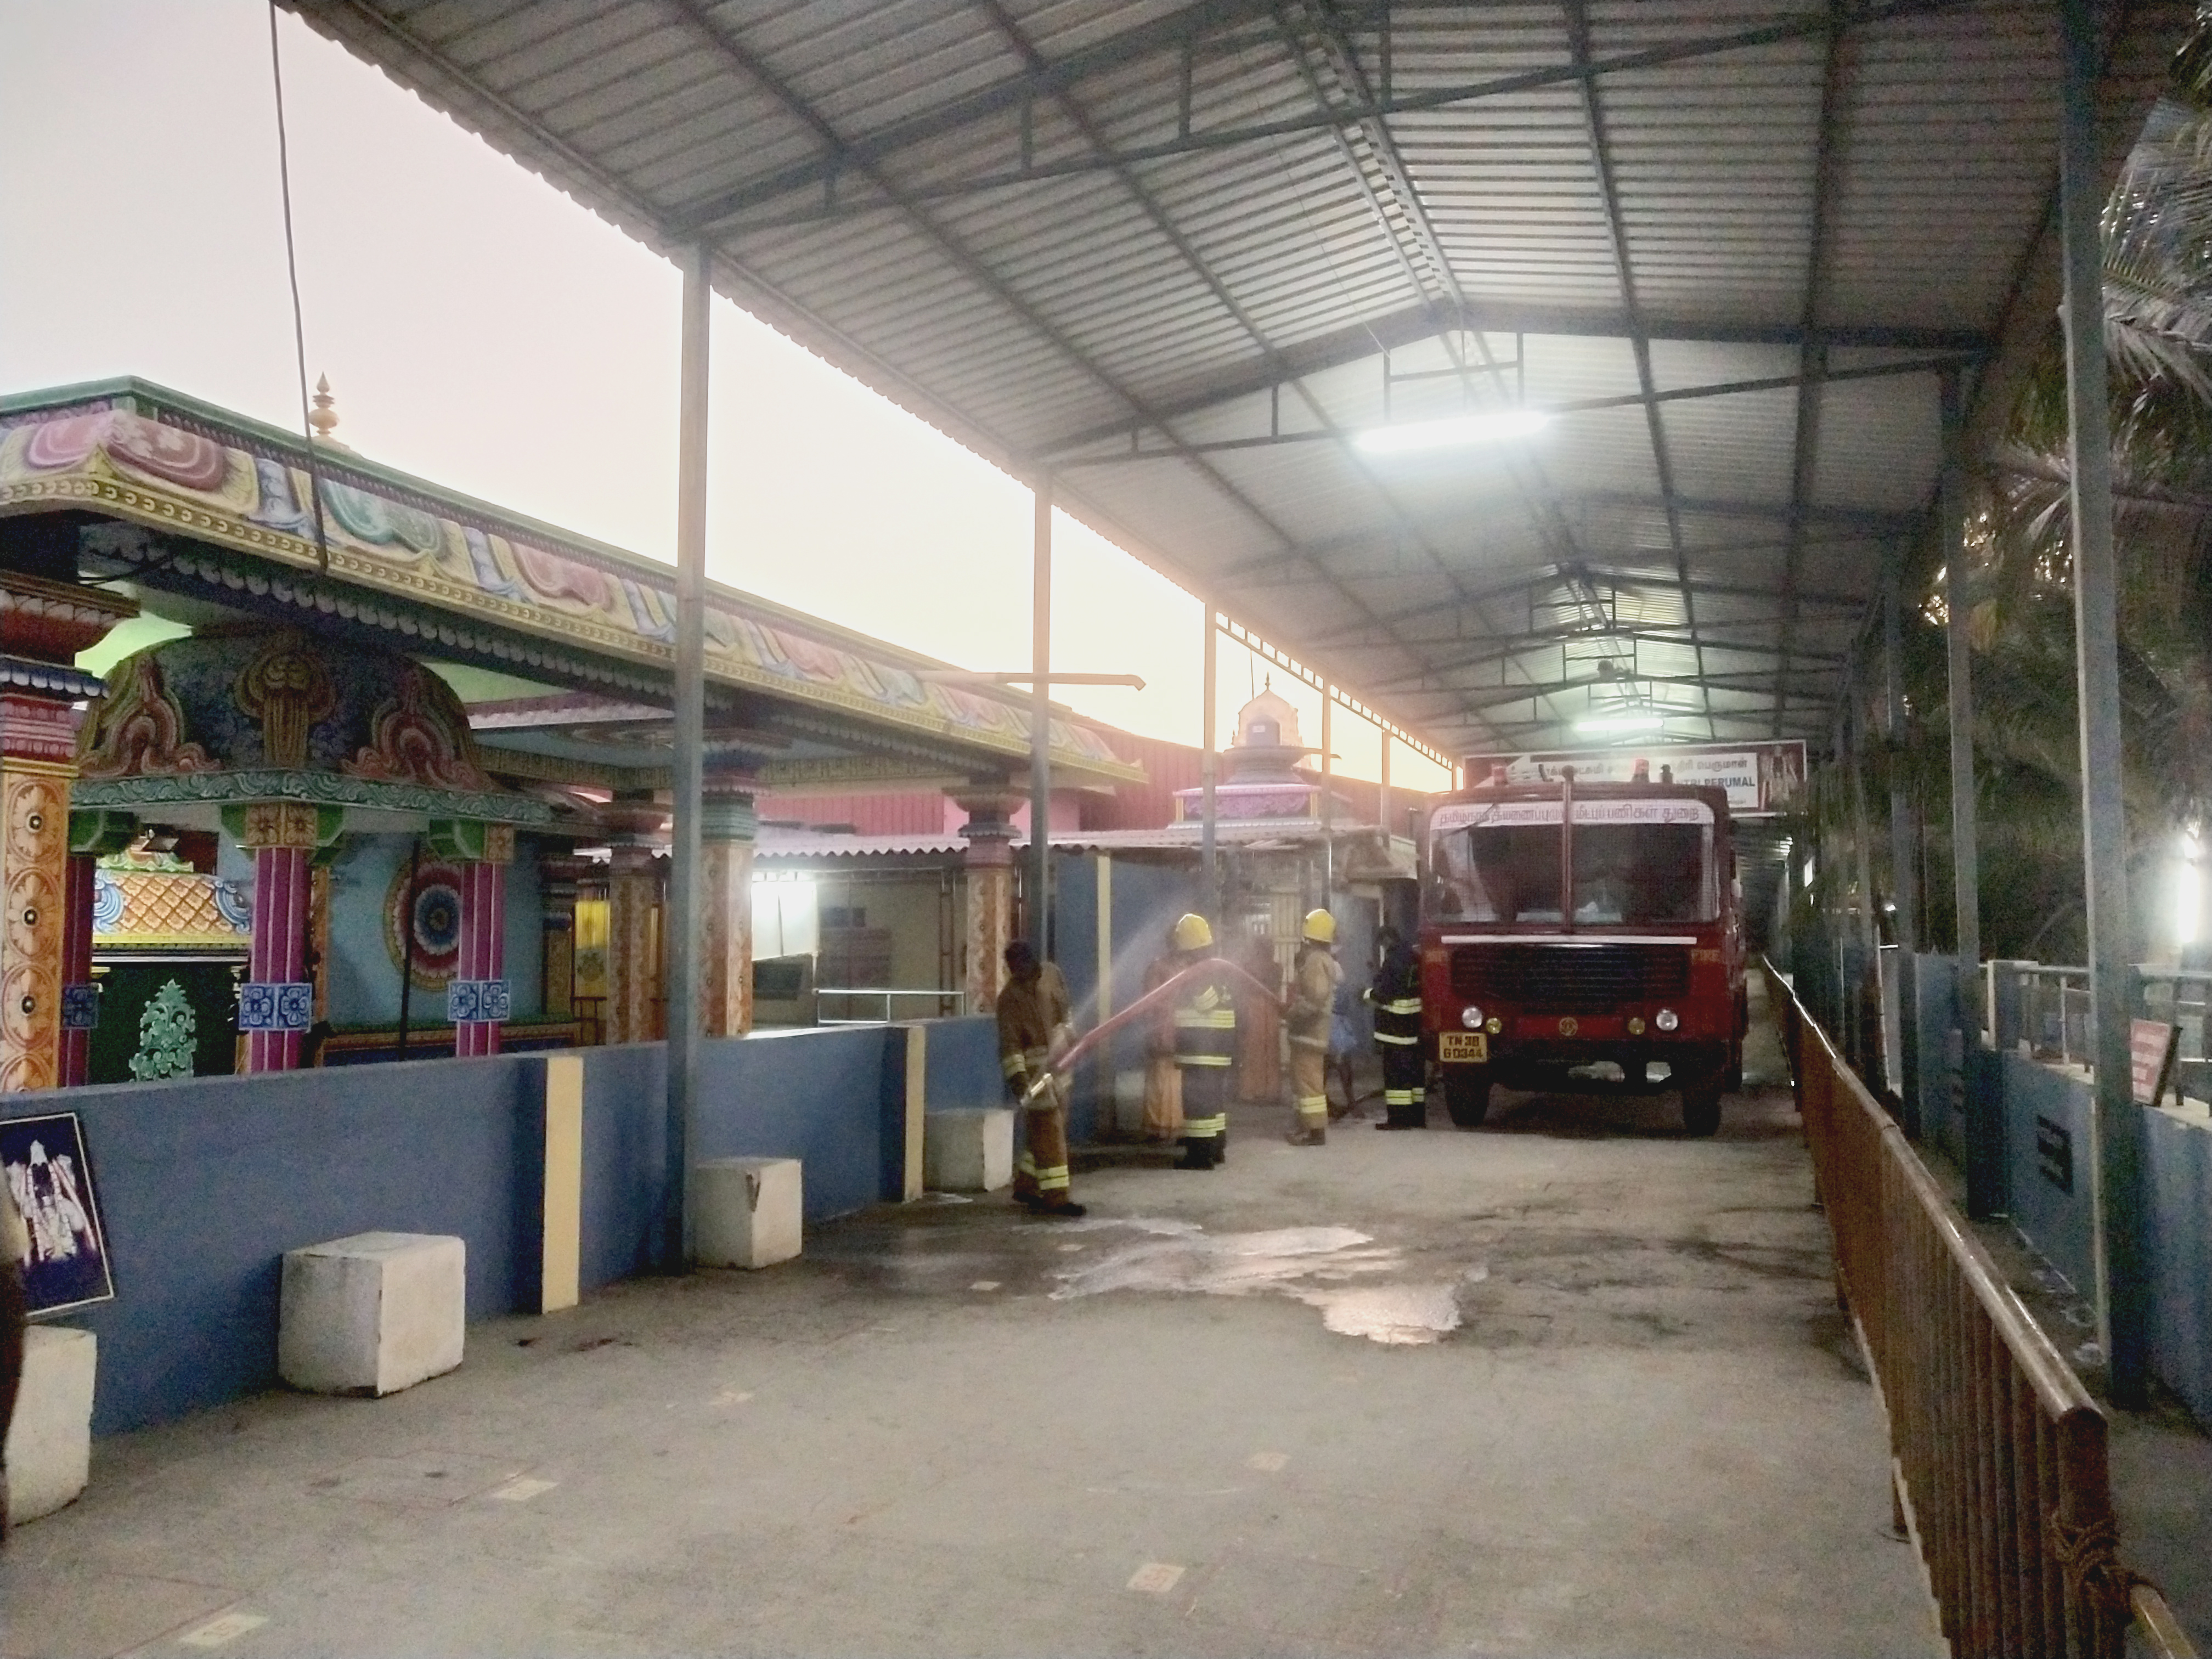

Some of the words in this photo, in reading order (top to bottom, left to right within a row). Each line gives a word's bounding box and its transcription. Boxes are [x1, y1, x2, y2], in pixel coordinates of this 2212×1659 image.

[1705, 776, 1756, 788] PERUMAL
[1662, 807, 1699, 823] துறை
[1447, 1036, 1462, 1046] TN
